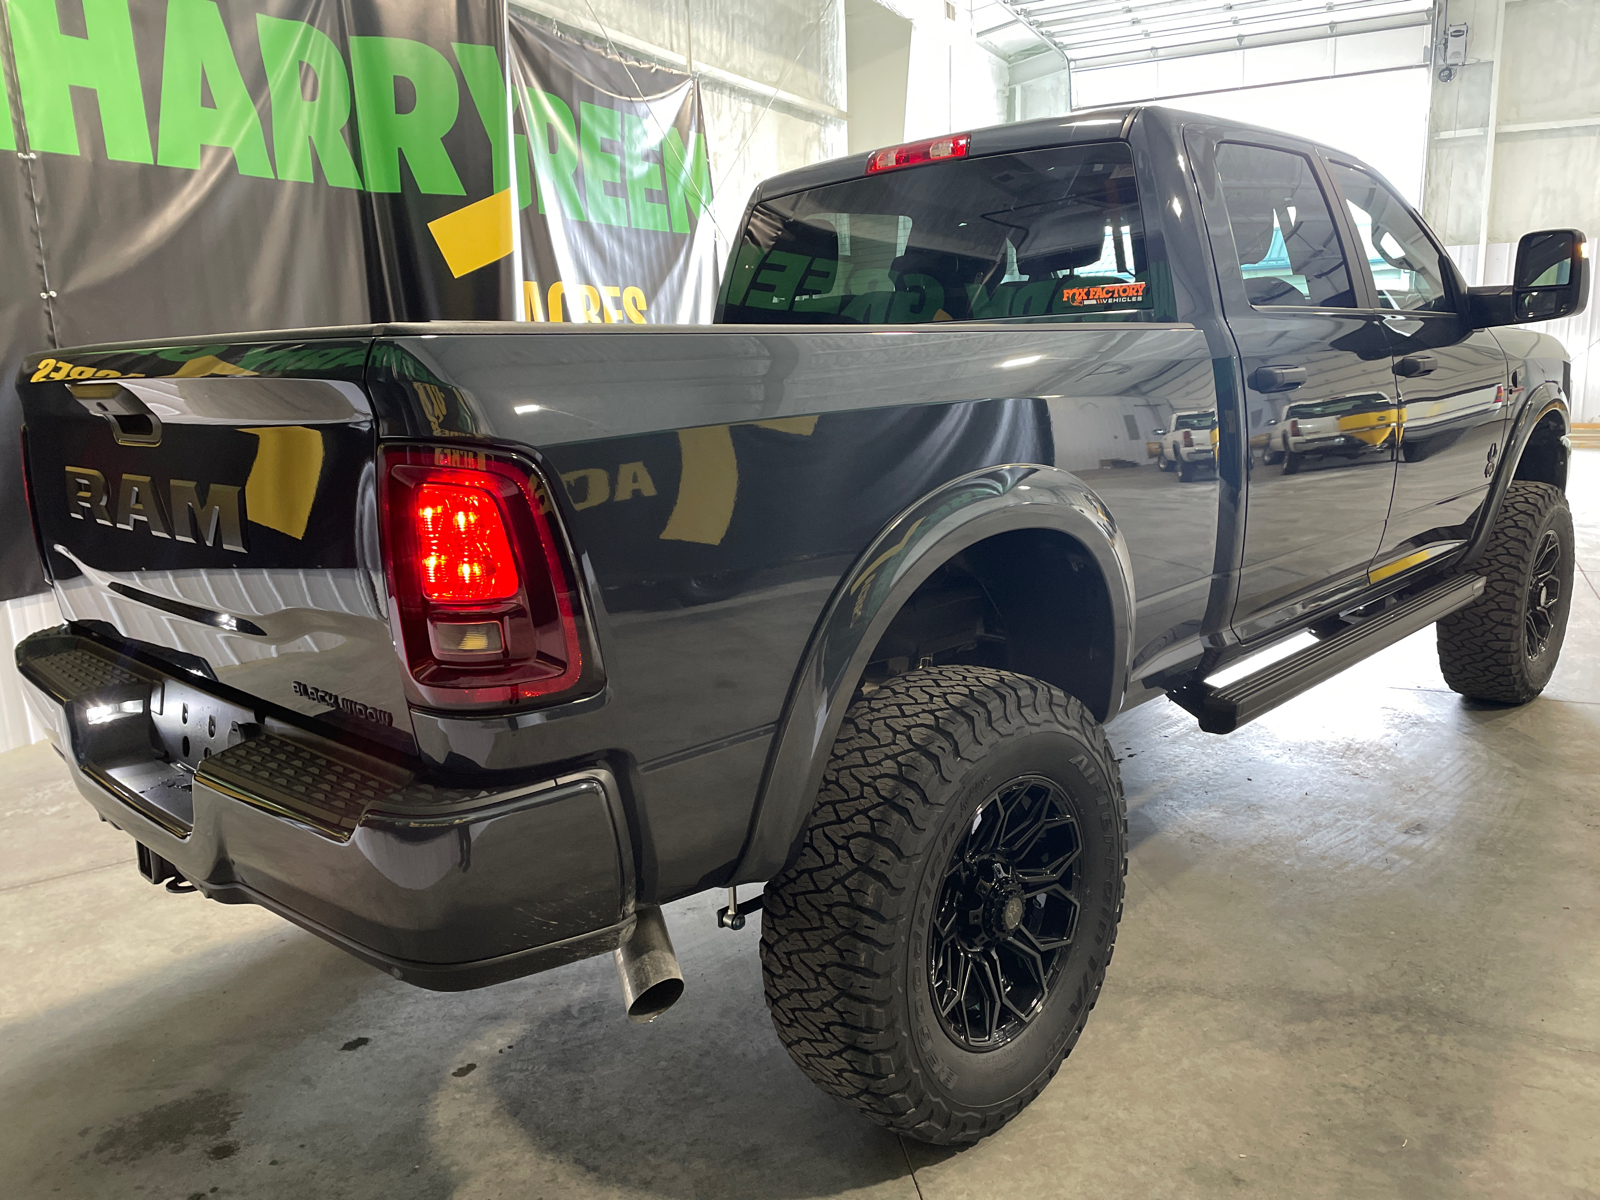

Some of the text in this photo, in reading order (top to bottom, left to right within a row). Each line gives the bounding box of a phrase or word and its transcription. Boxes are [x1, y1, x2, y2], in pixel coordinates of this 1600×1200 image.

[513, 84, 713, 234] REEN
[1062, 283, 1146, 306] FOX FACTORY
[1102, 296, 1143, 304] VEHICLES
[64, 465, 248, 554] RAM
[340, 697, 393, 727] WIDOW
